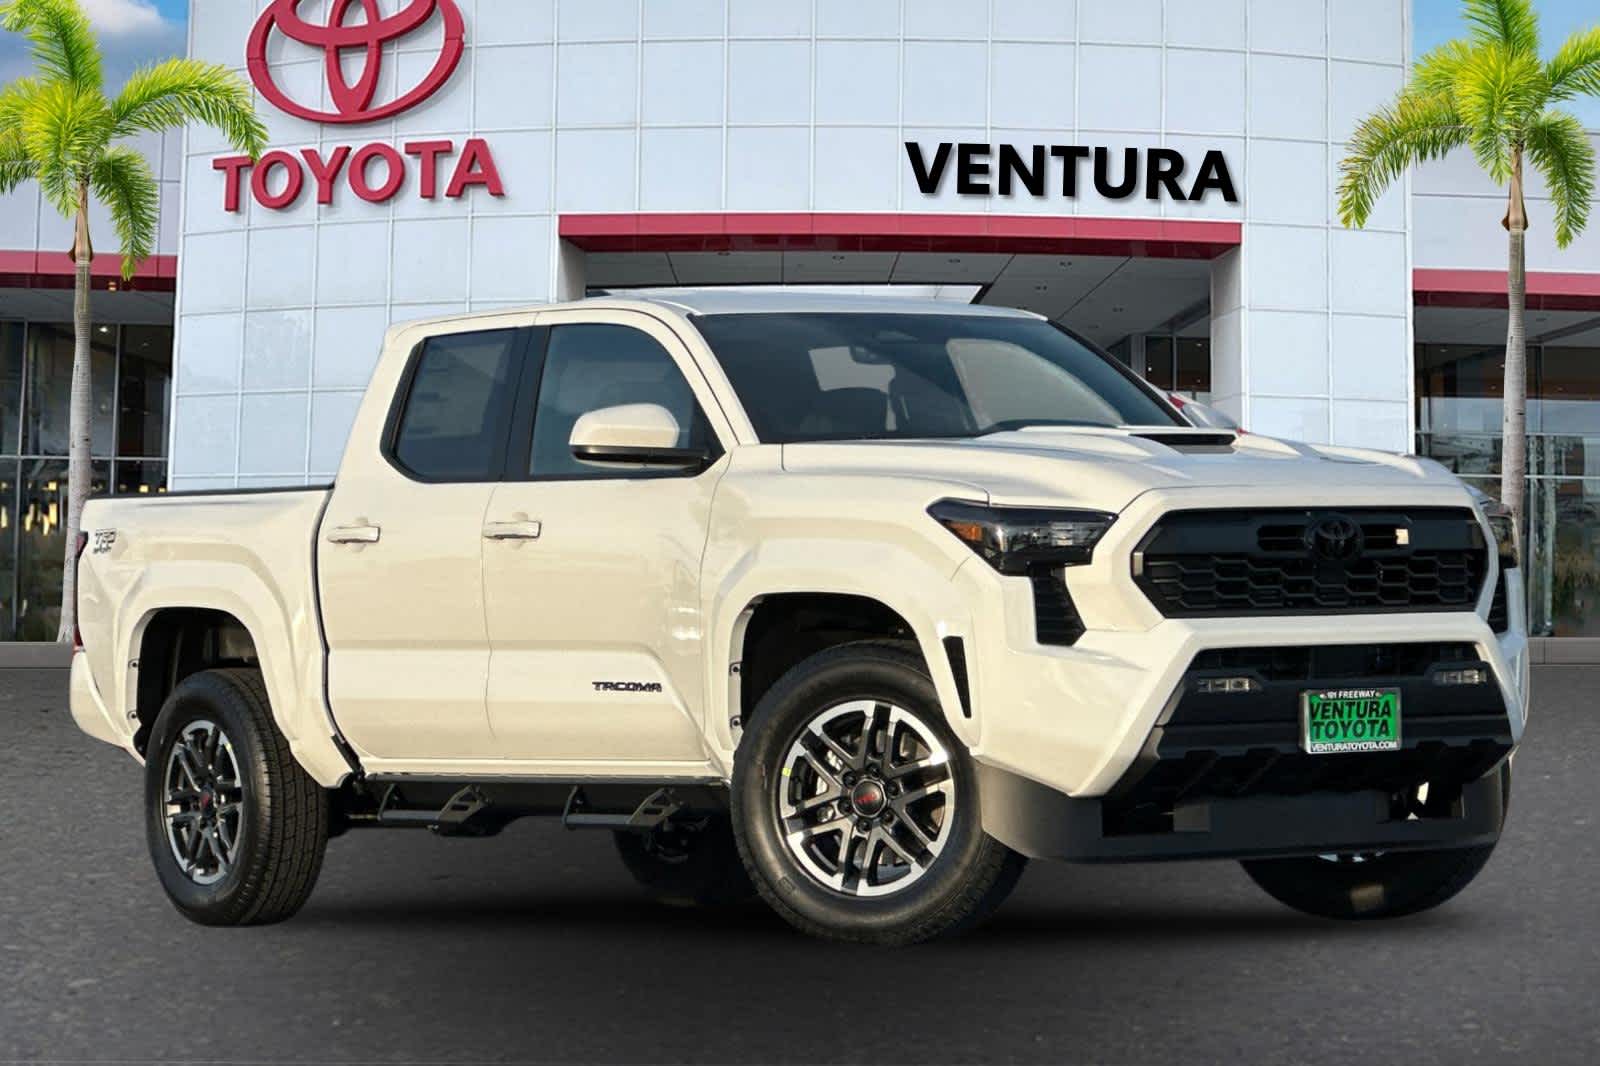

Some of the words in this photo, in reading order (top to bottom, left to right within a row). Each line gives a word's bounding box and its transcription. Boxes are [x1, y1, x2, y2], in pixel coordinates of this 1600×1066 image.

[212, 138, 505, 212] TOYOTA
[904, 142, 1240, 202] VENTURA
[592, 681, 662, 692] TACOMA
[1338, 690, 1376, 699] FREEWAY
[1310, 700, 1392, 719] VENTURA
[1313, 720, 1390, 739] TOYOTA
[1312, 741, 1398, 752] VENTURATOYOTA.COM
